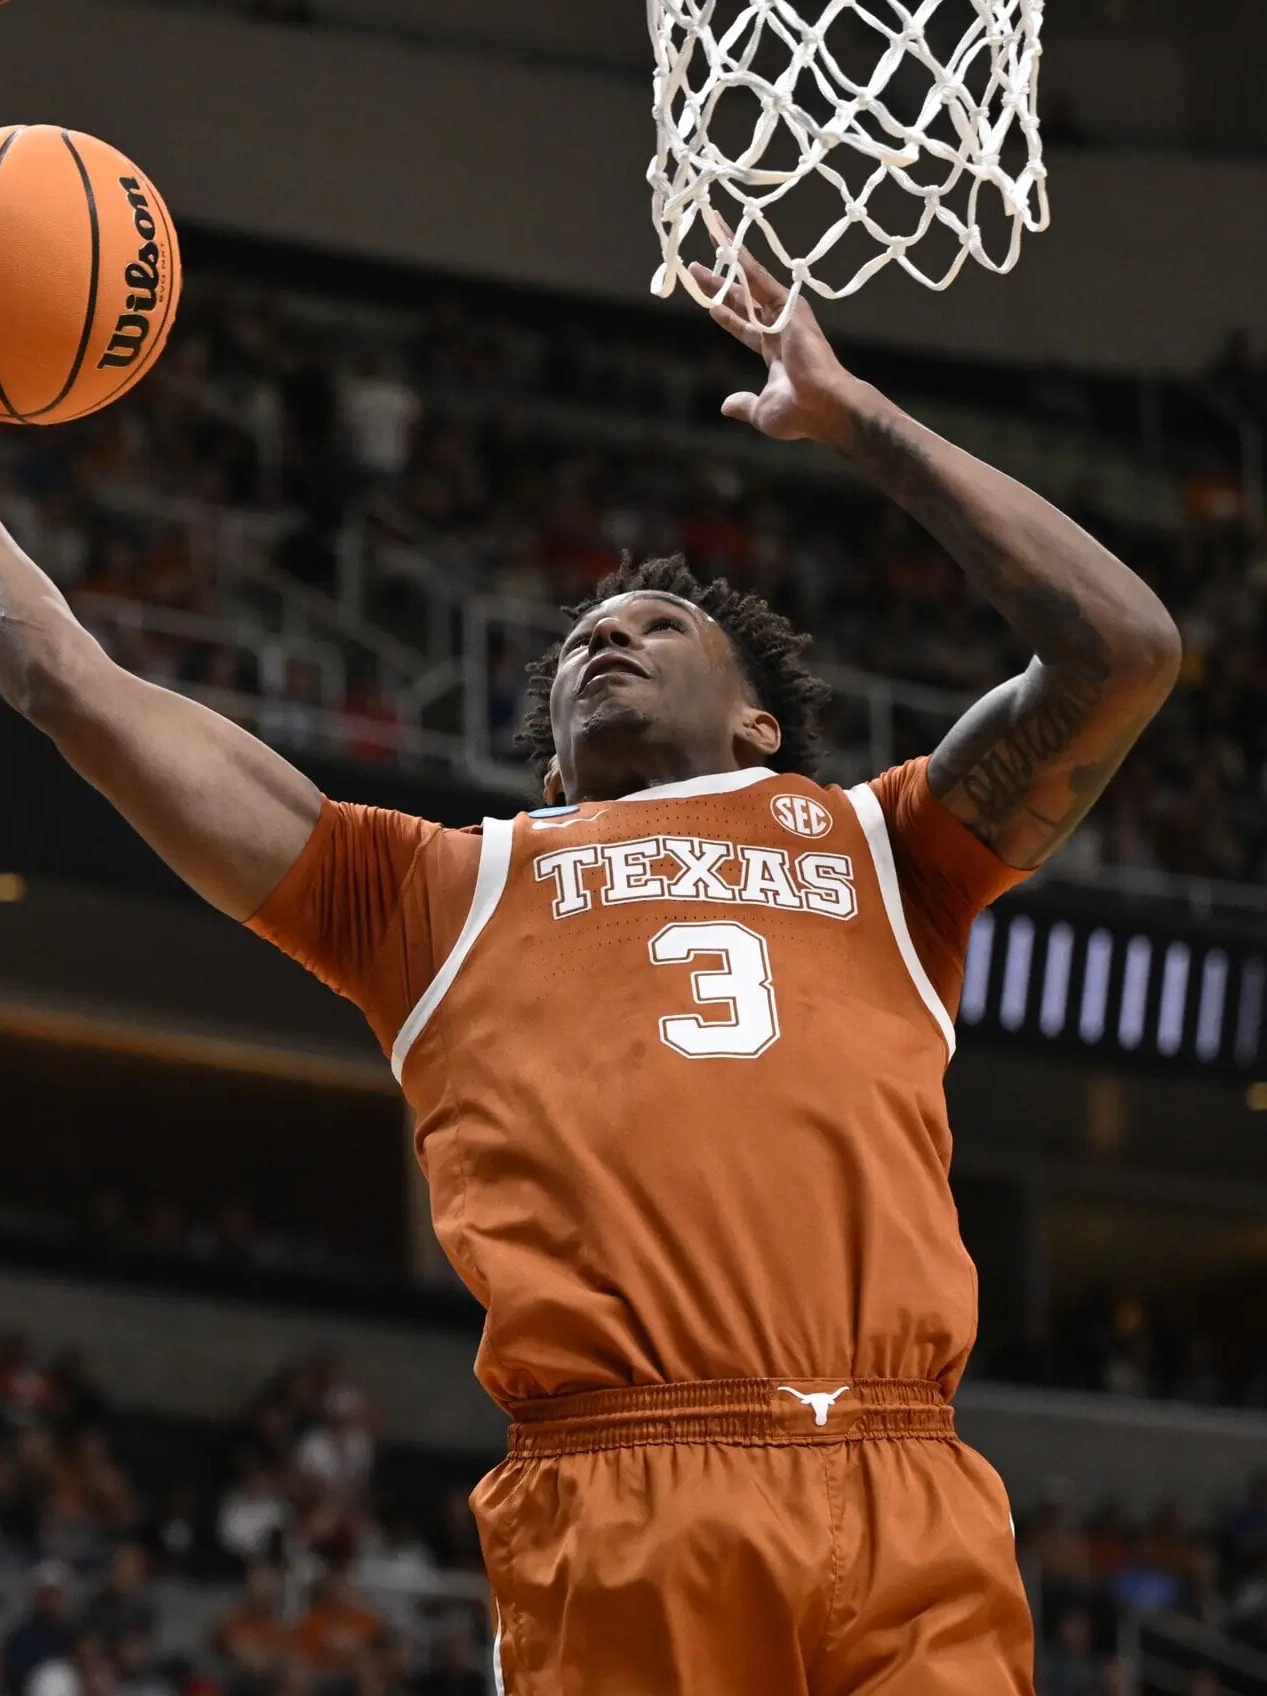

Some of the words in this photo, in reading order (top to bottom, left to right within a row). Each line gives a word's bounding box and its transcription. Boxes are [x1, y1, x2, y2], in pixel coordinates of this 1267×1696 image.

[97, 175, 160, 370] Wilson
[775, 796, 828, 835] SEC
[535, 836, 858, 920] TEXAS
[649, 921, 780, 1058] 3
